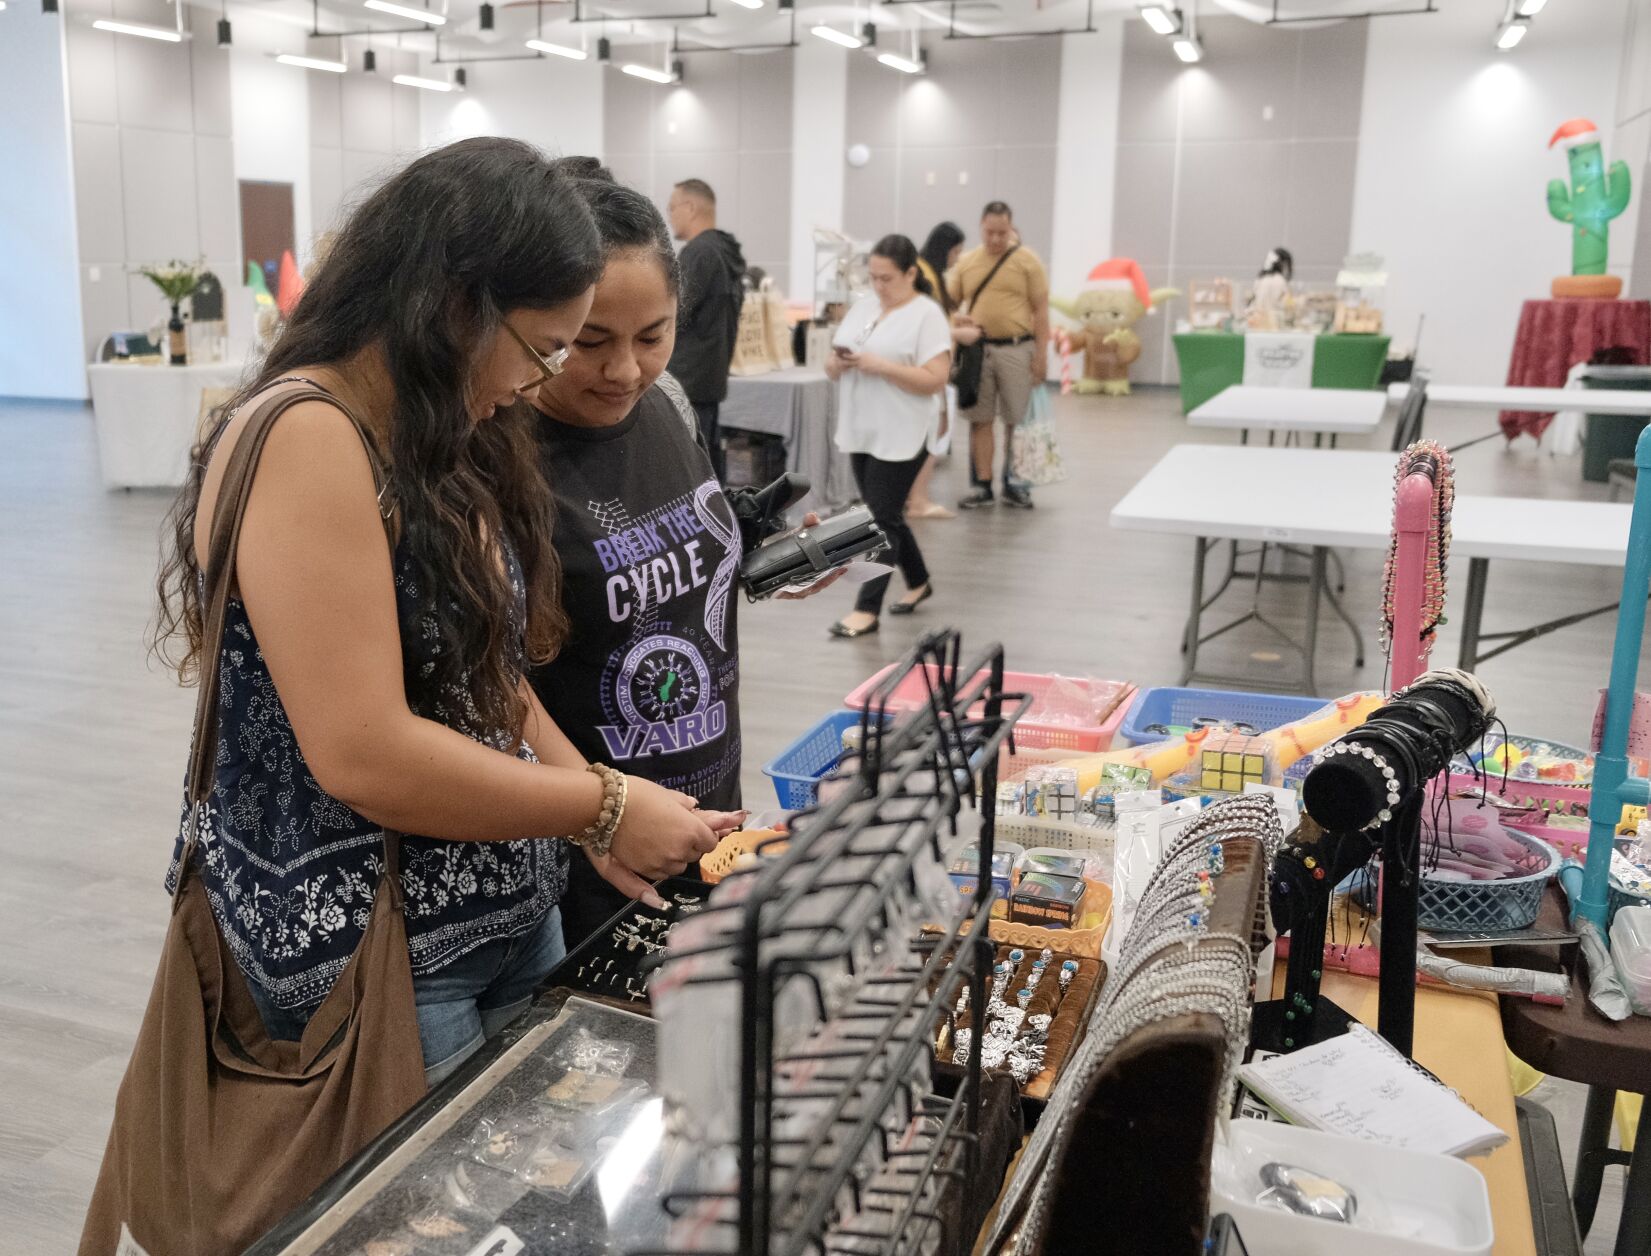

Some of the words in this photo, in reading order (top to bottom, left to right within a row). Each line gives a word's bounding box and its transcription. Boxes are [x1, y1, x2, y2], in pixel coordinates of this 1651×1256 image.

[592, 521, 668, 574] BREAK
[658, 502, 706, 544] THE
[606, 540, 708, 623] CYCLE
[682, 626, 696, 636] 40
[623, 639, 664, 681] ADVOCATES
[667, 639, 706, 678] REACHING
[620, 685, 637, 723] VICTIM
[595, 700, 728, 761] VARO
[655, 775, 687, 787] ICTIM
